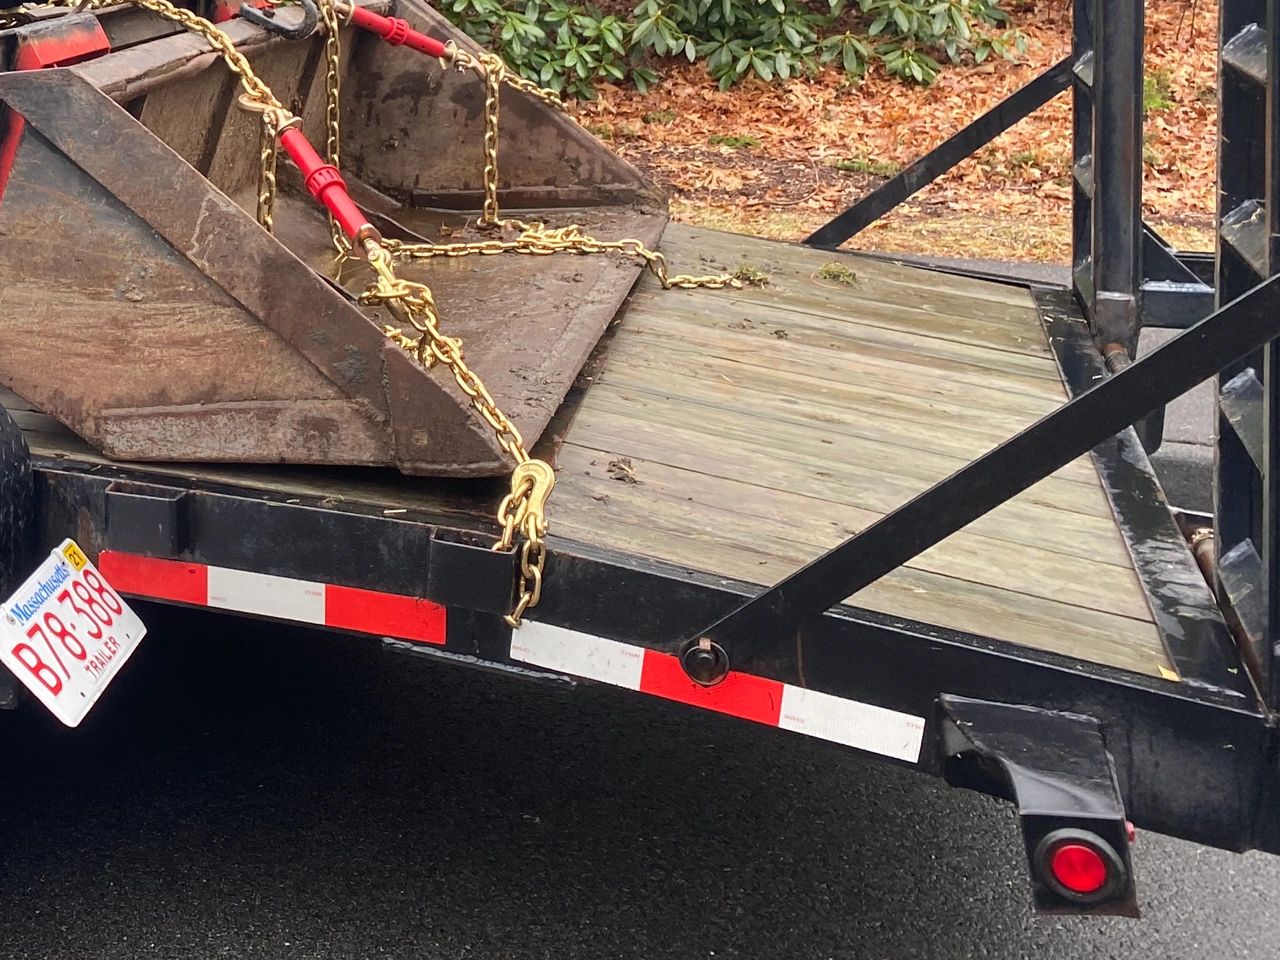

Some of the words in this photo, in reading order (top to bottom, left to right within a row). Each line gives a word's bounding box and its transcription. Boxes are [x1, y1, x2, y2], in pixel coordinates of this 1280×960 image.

[69, 551, 83, 567] 21
[10, 562, 71, 626] Massachusetts
[85, 636, 120, 678] TRAILER
